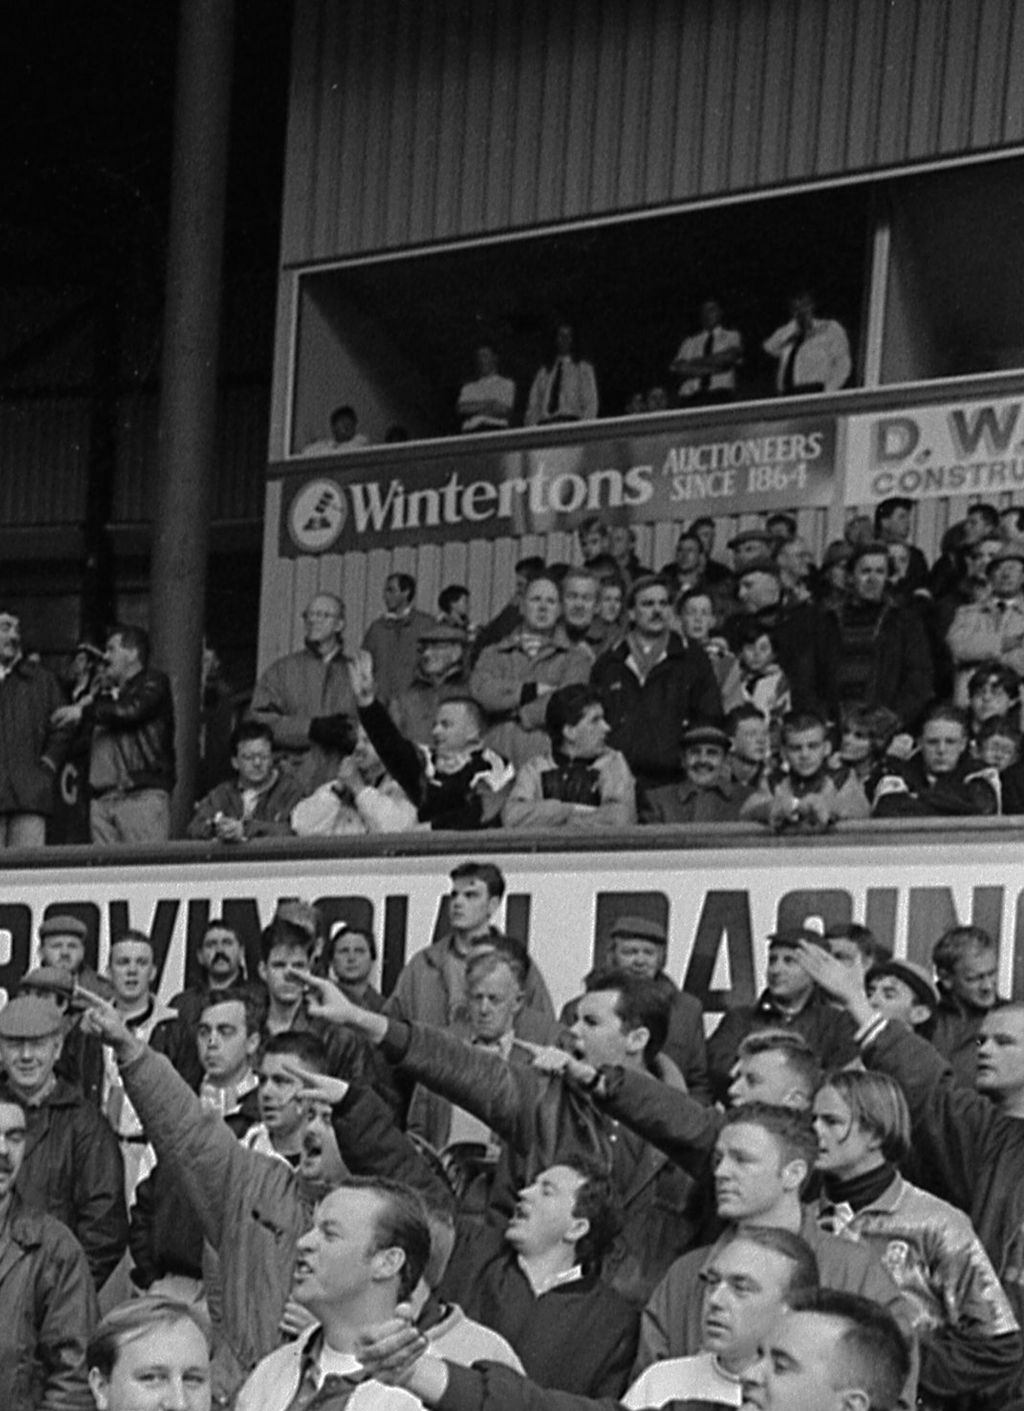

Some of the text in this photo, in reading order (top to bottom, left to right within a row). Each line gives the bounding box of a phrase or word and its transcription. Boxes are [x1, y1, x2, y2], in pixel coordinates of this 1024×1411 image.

[662, 432, 825, 476] AUCTIONEERS
[349, 461, 654, 534] Wintertons
[671, 469, 737, 502] SINCE
